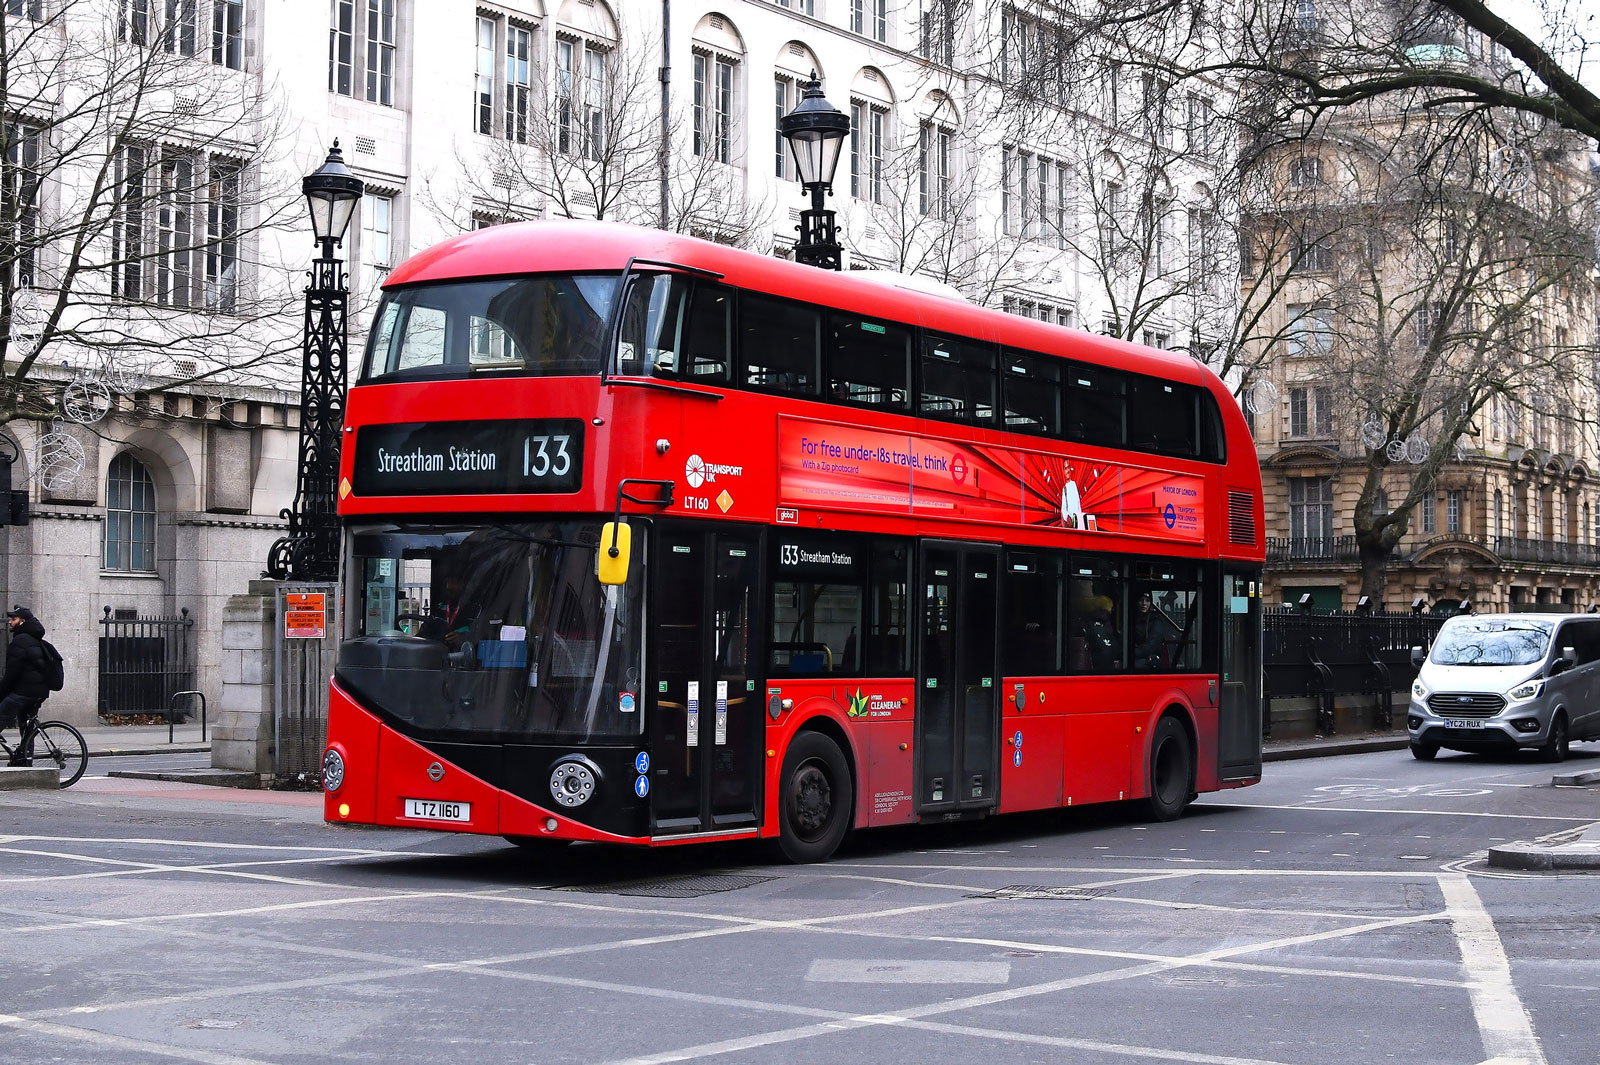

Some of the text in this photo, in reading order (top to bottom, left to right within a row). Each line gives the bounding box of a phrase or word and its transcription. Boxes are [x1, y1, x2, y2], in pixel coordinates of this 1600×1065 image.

[377, 435, 571, 477] Streatham Station 133
[801, 437, 948, 471] For free under-18s travel, think
[705, 462, 743, 476] TRANSPORT
[802, 459, 815, 469] With
[821, 461, 831, 471] Zip
[831, 463, 859, 474] photocard
[706, 473, 716, 482] UK
[684, 496, 709, 510] LT160
[780, 544, 852, 565] 133 Streatham Station
[1449, 720, 1465, 728] YC21
[414, 801, 460, 818] LTZ 1160
